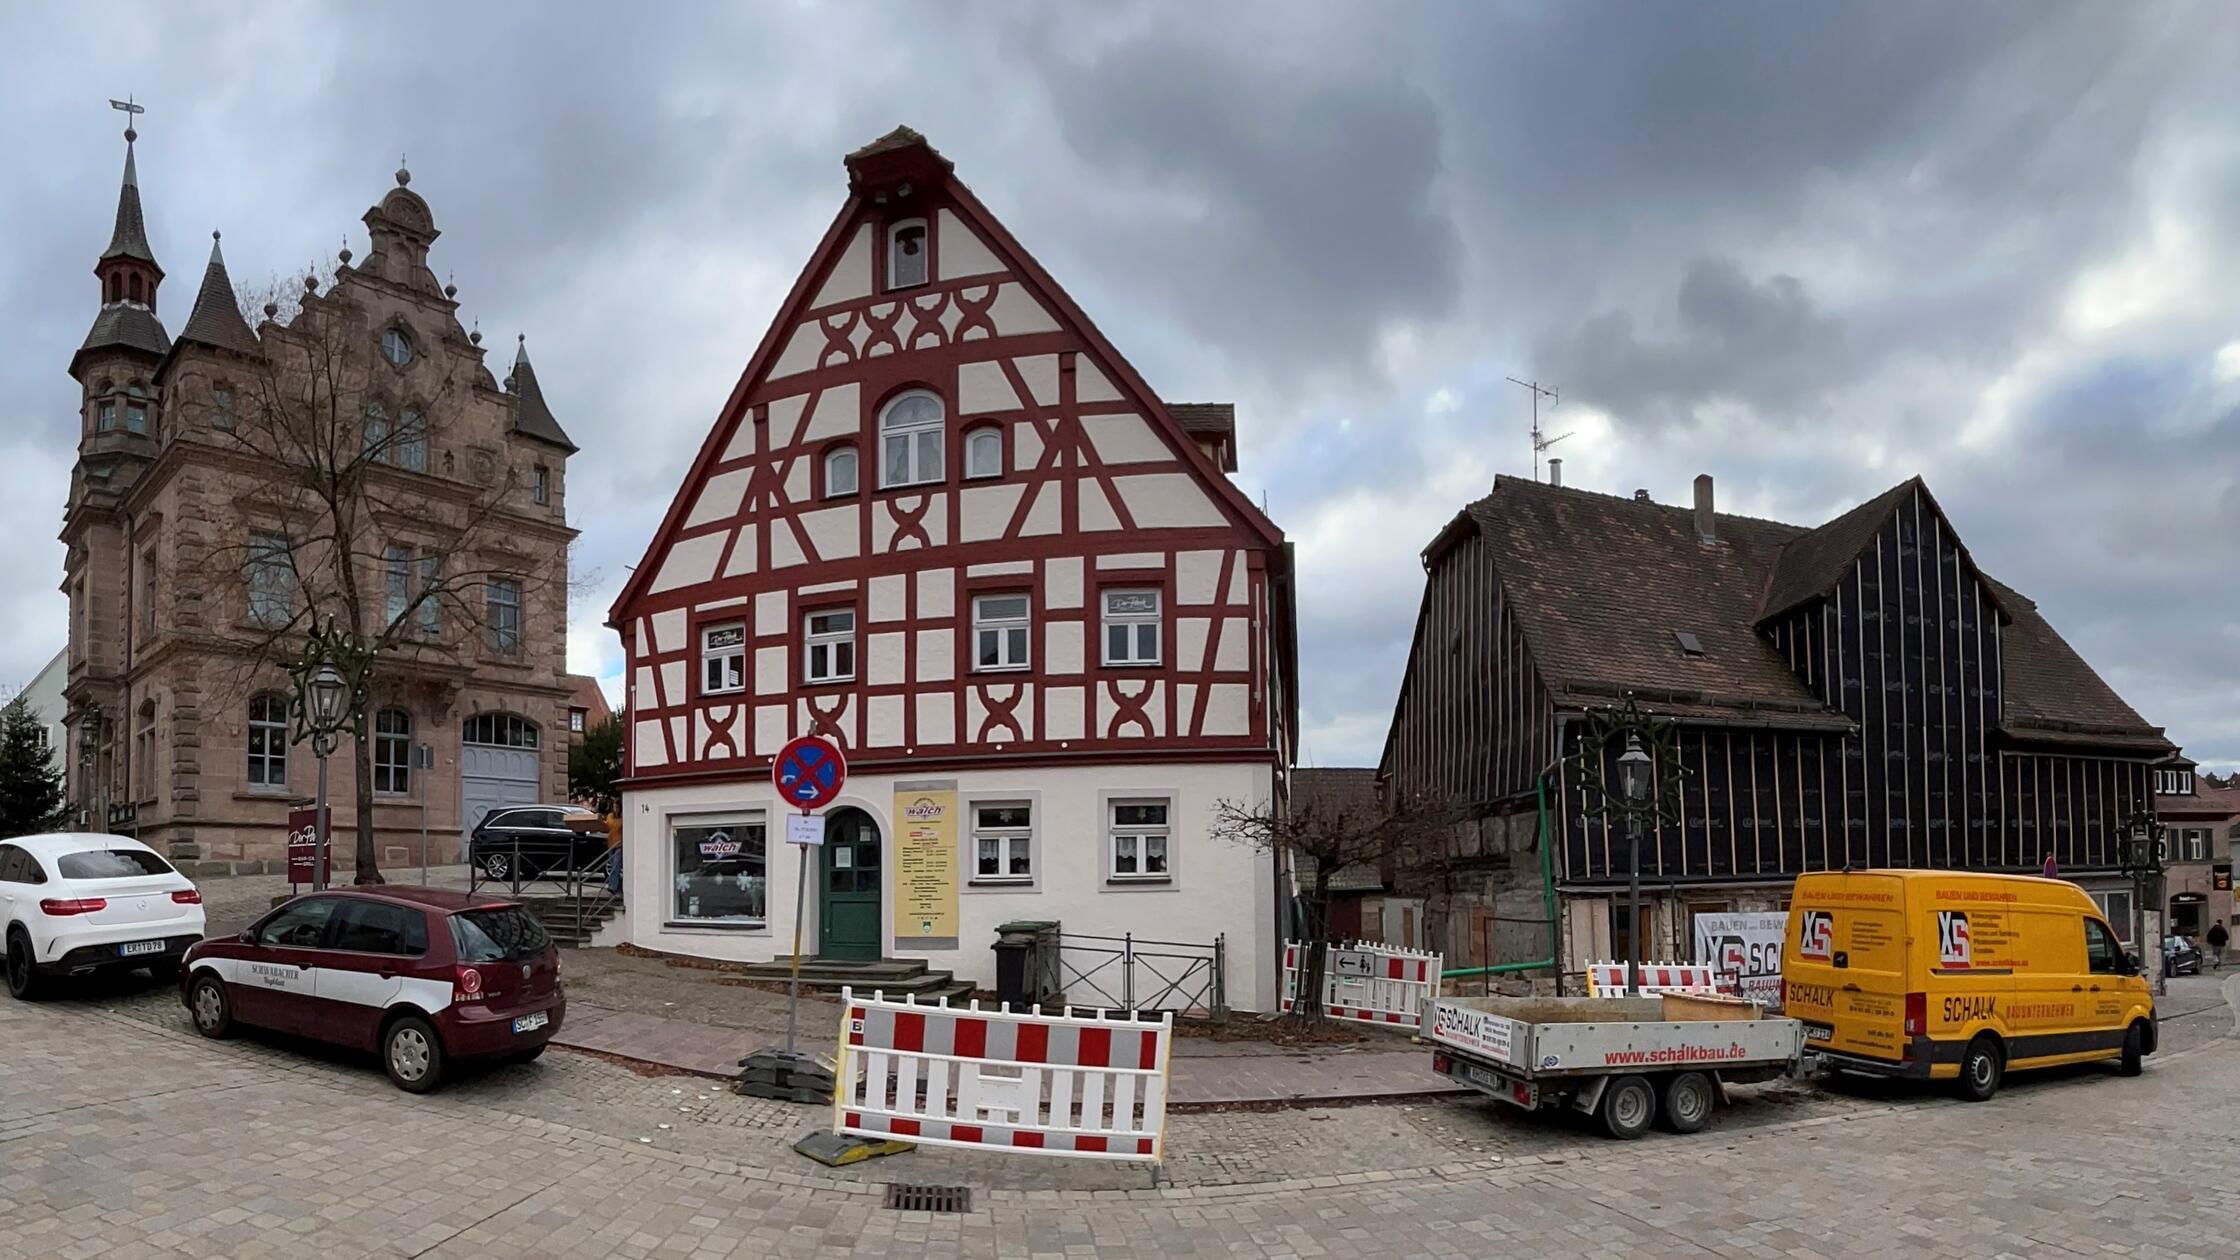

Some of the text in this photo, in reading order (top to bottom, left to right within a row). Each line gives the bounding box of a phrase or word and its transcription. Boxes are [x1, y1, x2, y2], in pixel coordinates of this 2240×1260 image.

[641, 803, 650, 814] 14
[908, 806, 942, 815] walch
[703, 842, 737, 853] walch
[1936, 890, 2017, 902] BAUEN UND BEWAHREN
[1711, 920, 1748, 932] BAUEN
[1749, 942, 1784, 976] SC
[1790, 984, 1834, 1007] SCHALK
[1944, 996, 1996, 1022] SCHALK
[1446, 1008, 1482, 1038] SCHALK
[1604, 1045, 1748, 1065] www.schalkbau.de
